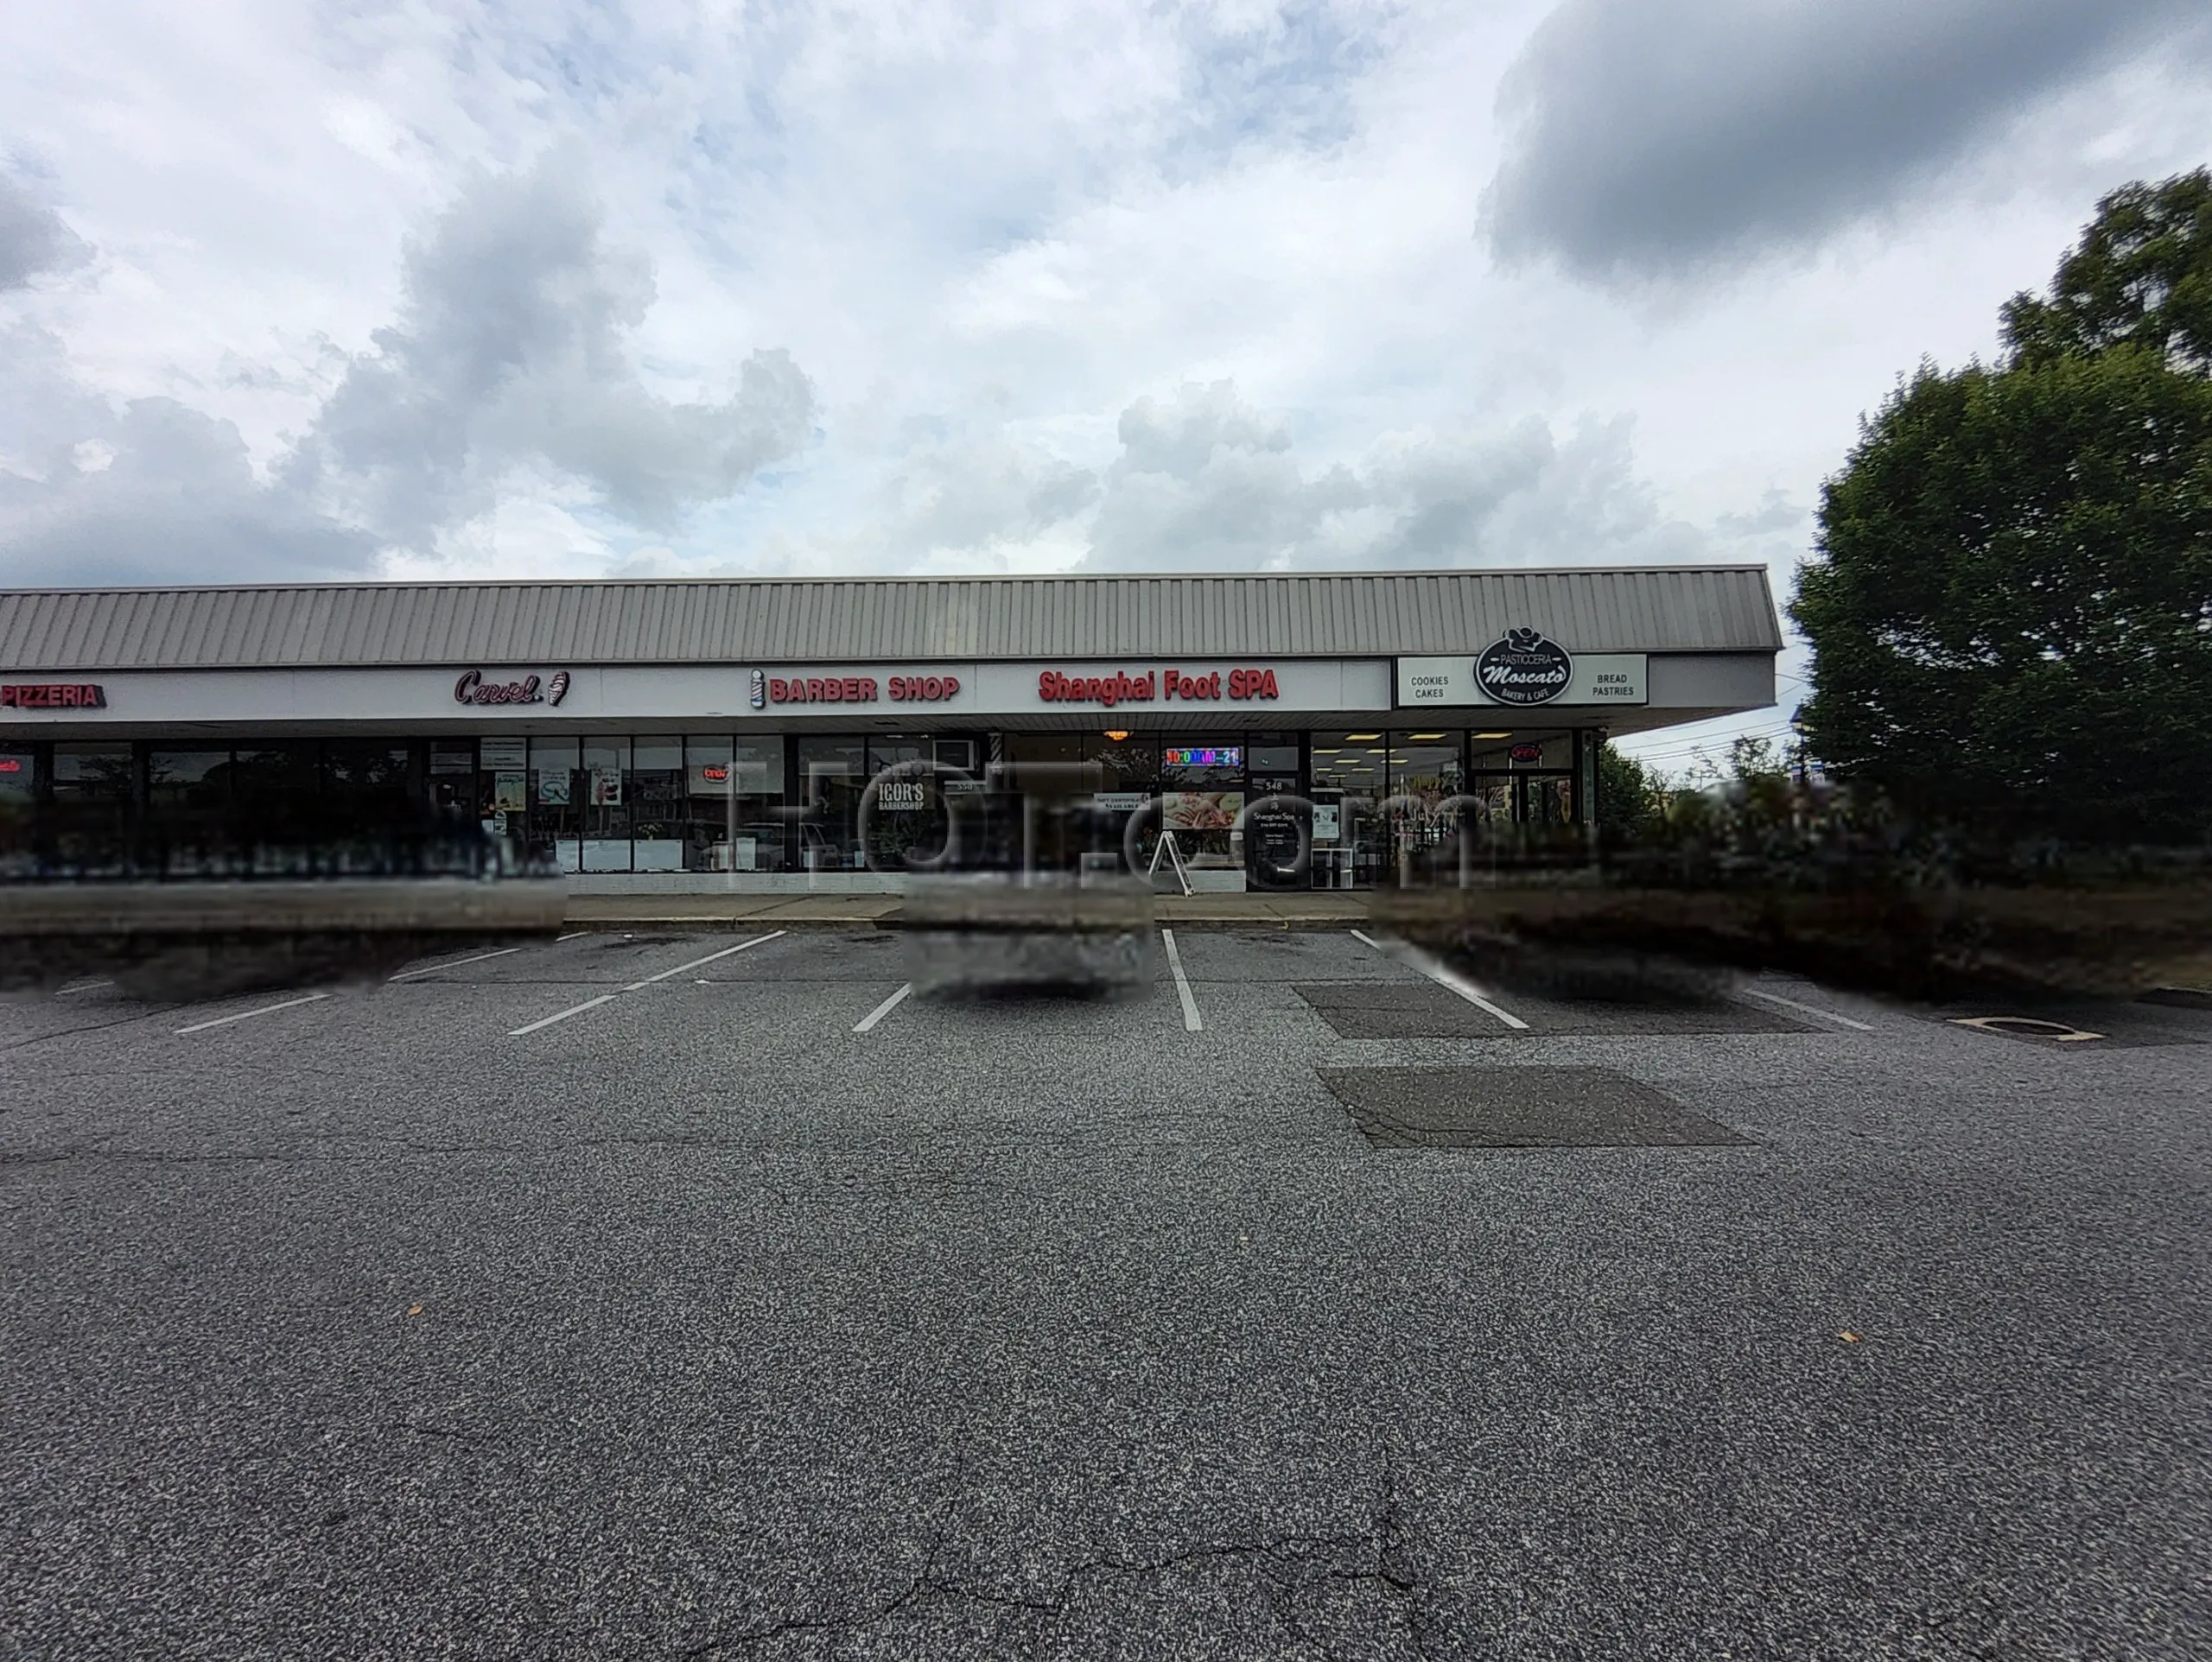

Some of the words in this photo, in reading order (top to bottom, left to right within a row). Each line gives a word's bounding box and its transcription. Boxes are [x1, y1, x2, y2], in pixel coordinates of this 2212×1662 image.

[1500, 654, 1552, 665] PASTICCERIA
[1483, 664, 1567, 684] Moscato
[1597, 674, 1628, 684] BREAD
[454, 669, 537, 703] Carvel
[1411, 676, 1449, 686] COOKIES
[769, 678, 878, 702] BARBER
[888, 676, 960, 701] SHOP
[1039, 670, 1155, 707] Shanghai
[1164, 669, 1221, 700] Foot
[1228, 669, 1280, 700] SPA
[1415, 688, 1444, 698] CAKES
[1592, 687, 1634, 696] PASTRIES
[1, 685, 100, 707] PIZZERIA
[1500, 688, 1525, 701] BAKERY
[1527, 692, 1533, 701] &
[1265, 781, 1282, 790] 548
[878, 783, 925, 802] IGOR'S
[878, 801, 925, 811] BARBERSHOP
